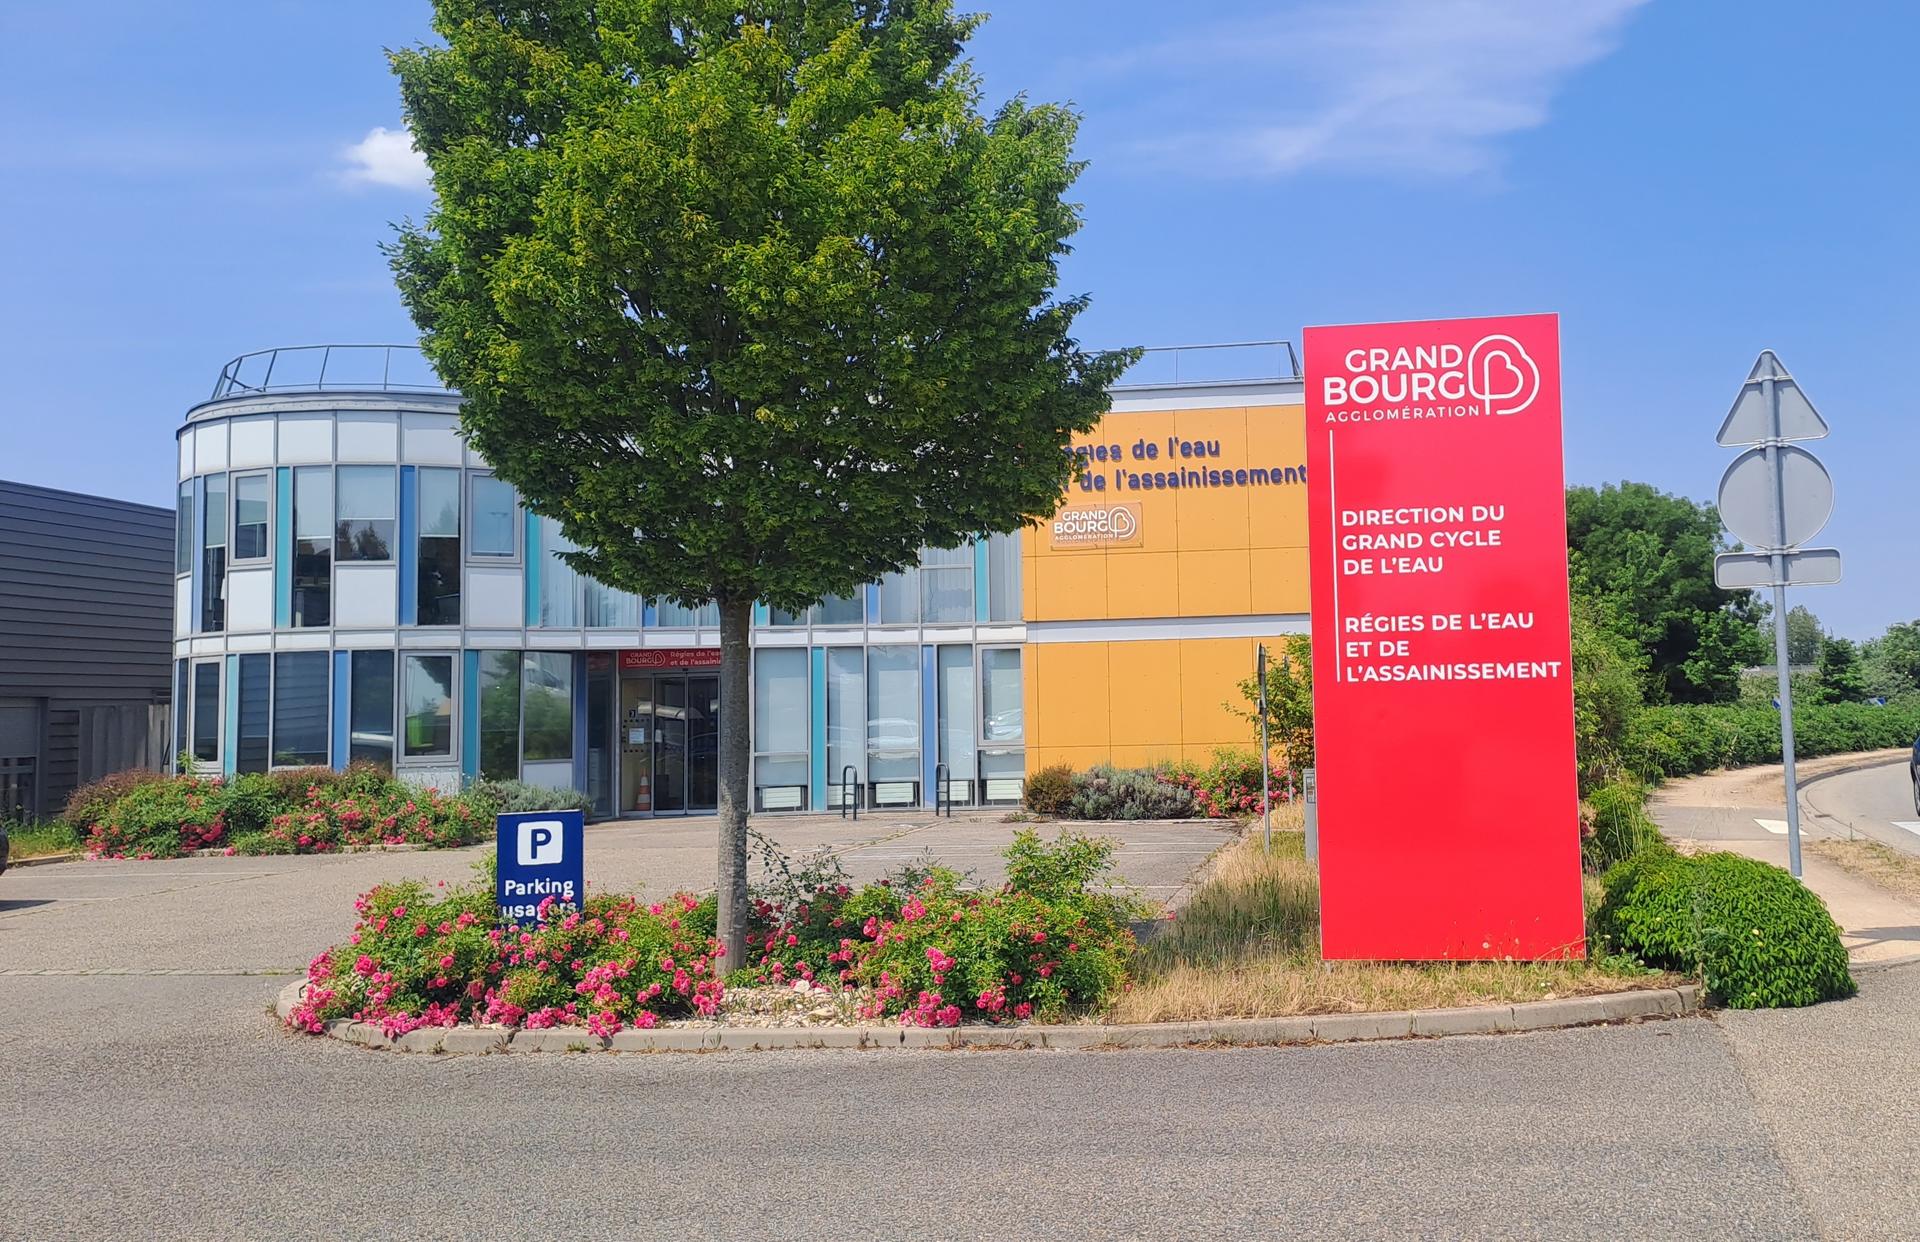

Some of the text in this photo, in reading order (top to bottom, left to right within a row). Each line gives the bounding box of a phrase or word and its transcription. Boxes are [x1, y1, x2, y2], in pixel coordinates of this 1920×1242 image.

[1345, 344, 1463, 373] GRAND
[1323, 371, 1466, 406] BOURG
[1325, 404, 1479, 423] AGGLOMÉRATION
[1132, 438, 1159, 461] de
[1168, 436, 1221, 459] l'eau
[1080, 470, 1106, 492] de
[1116, 464, 1307, 491] l'assainissement
[1062, 510, 1107, 521] GRAND
[1341, 505, 1505, 527] DIRECTION DU
[1054, 520, 1108, 534] BOURG
[1342, 530, 1502, 551] GRAND CYCLE
[1343, 556, 1444, 576] DE L’EAU
[1344, 612, 1534, 633] RÉGIES DE L’EAU
[1346, 640, 1410, 658] ET DE
[625, 657, 653, 665] BOURG
[1346, 661, 1562, 683] L’ASSAINISSEMENT
[530, 828, 552, 859] P
[504, 878, 575, 898] Parking
[502, 902, 577, 921] usars
